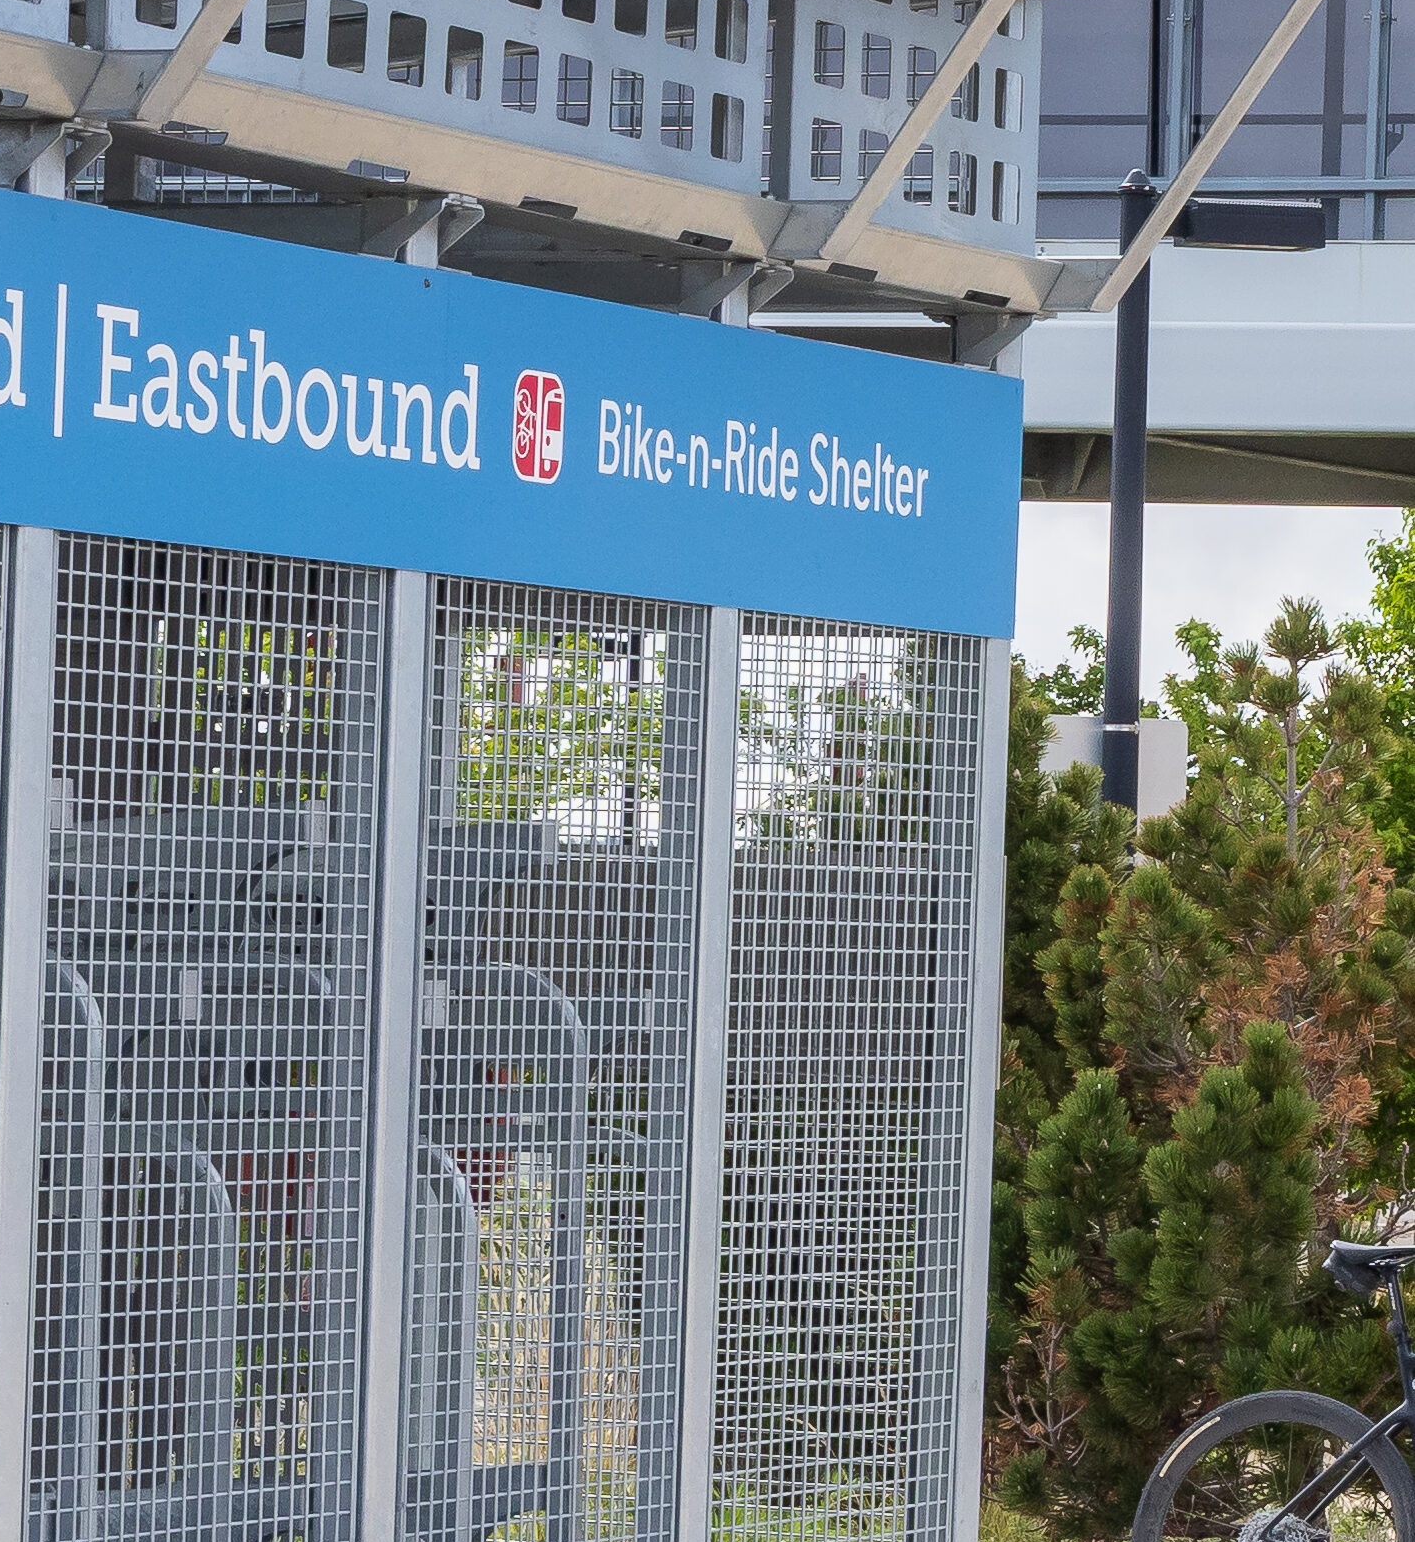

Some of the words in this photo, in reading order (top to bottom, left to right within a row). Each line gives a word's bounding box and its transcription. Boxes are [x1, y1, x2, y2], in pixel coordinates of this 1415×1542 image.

[93, 303, 481, 471] Eastbound
[598, 398, 800, 502] Bike-n-Ride
[808, 432, 929, 517] Shelter
